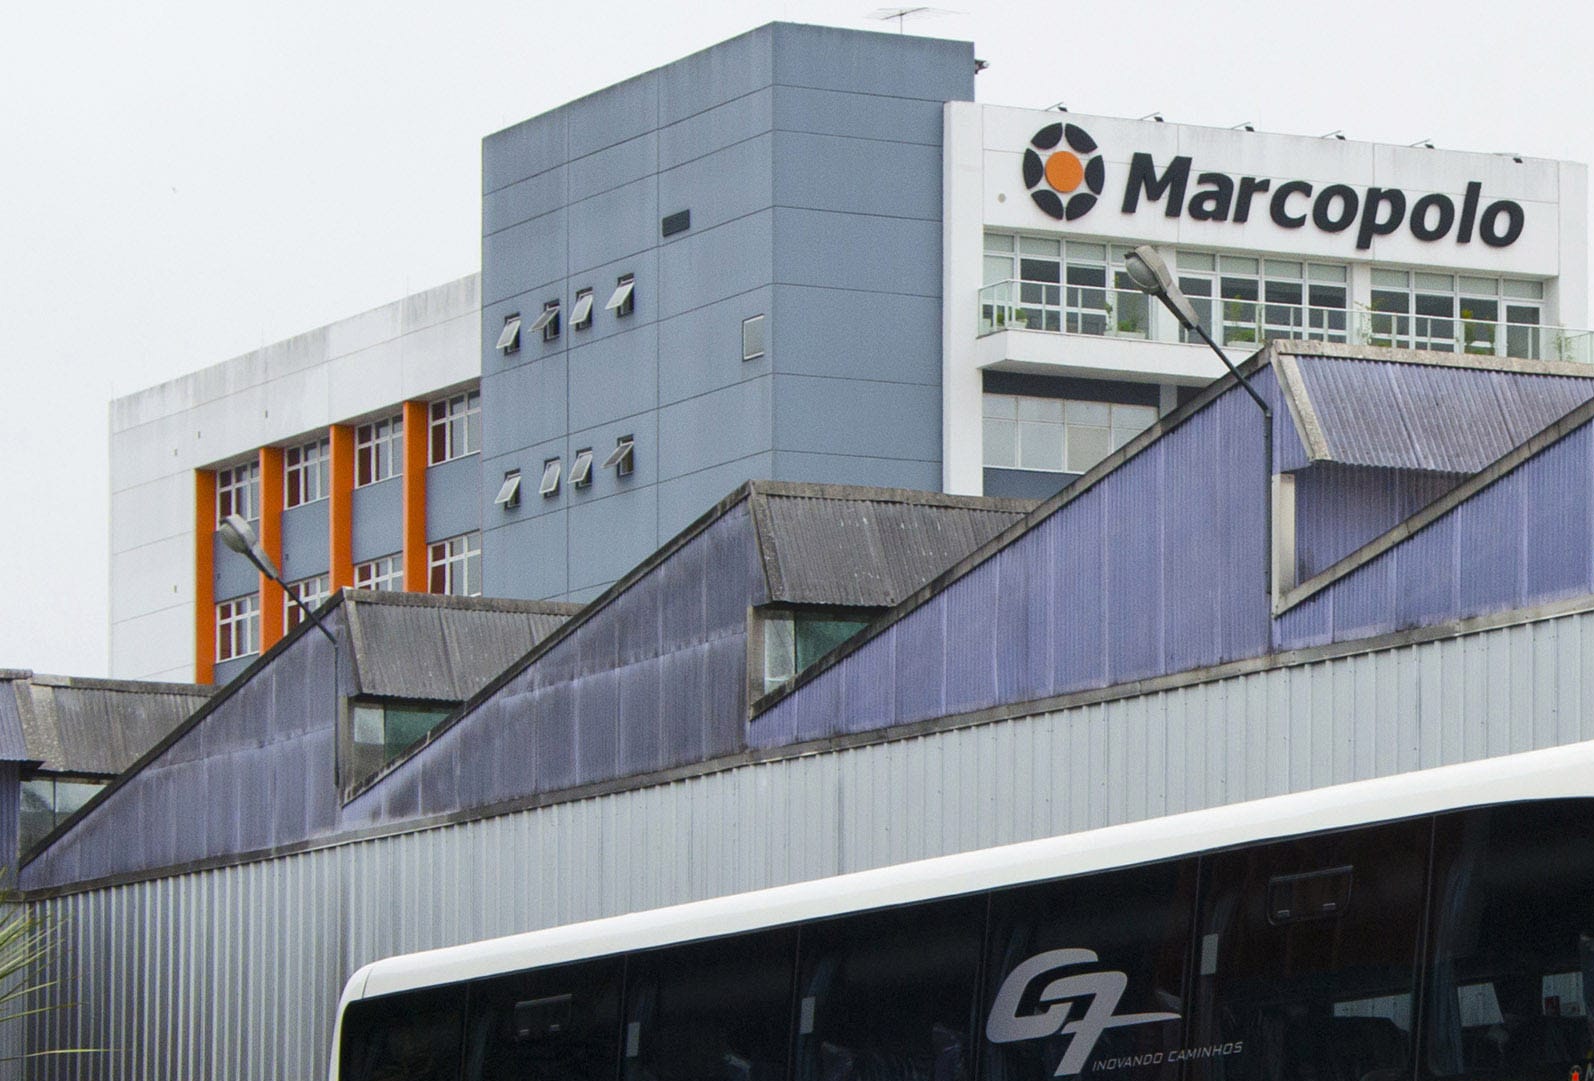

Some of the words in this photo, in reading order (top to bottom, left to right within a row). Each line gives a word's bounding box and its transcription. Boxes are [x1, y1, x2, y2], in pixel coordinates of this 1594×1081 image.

[1120, 151, 1526, 250] Marcopolo
[1092, 1052, 1164, 1072] INOVANDO
[1167, 1041, 1244, 1063] CAMINHOS
